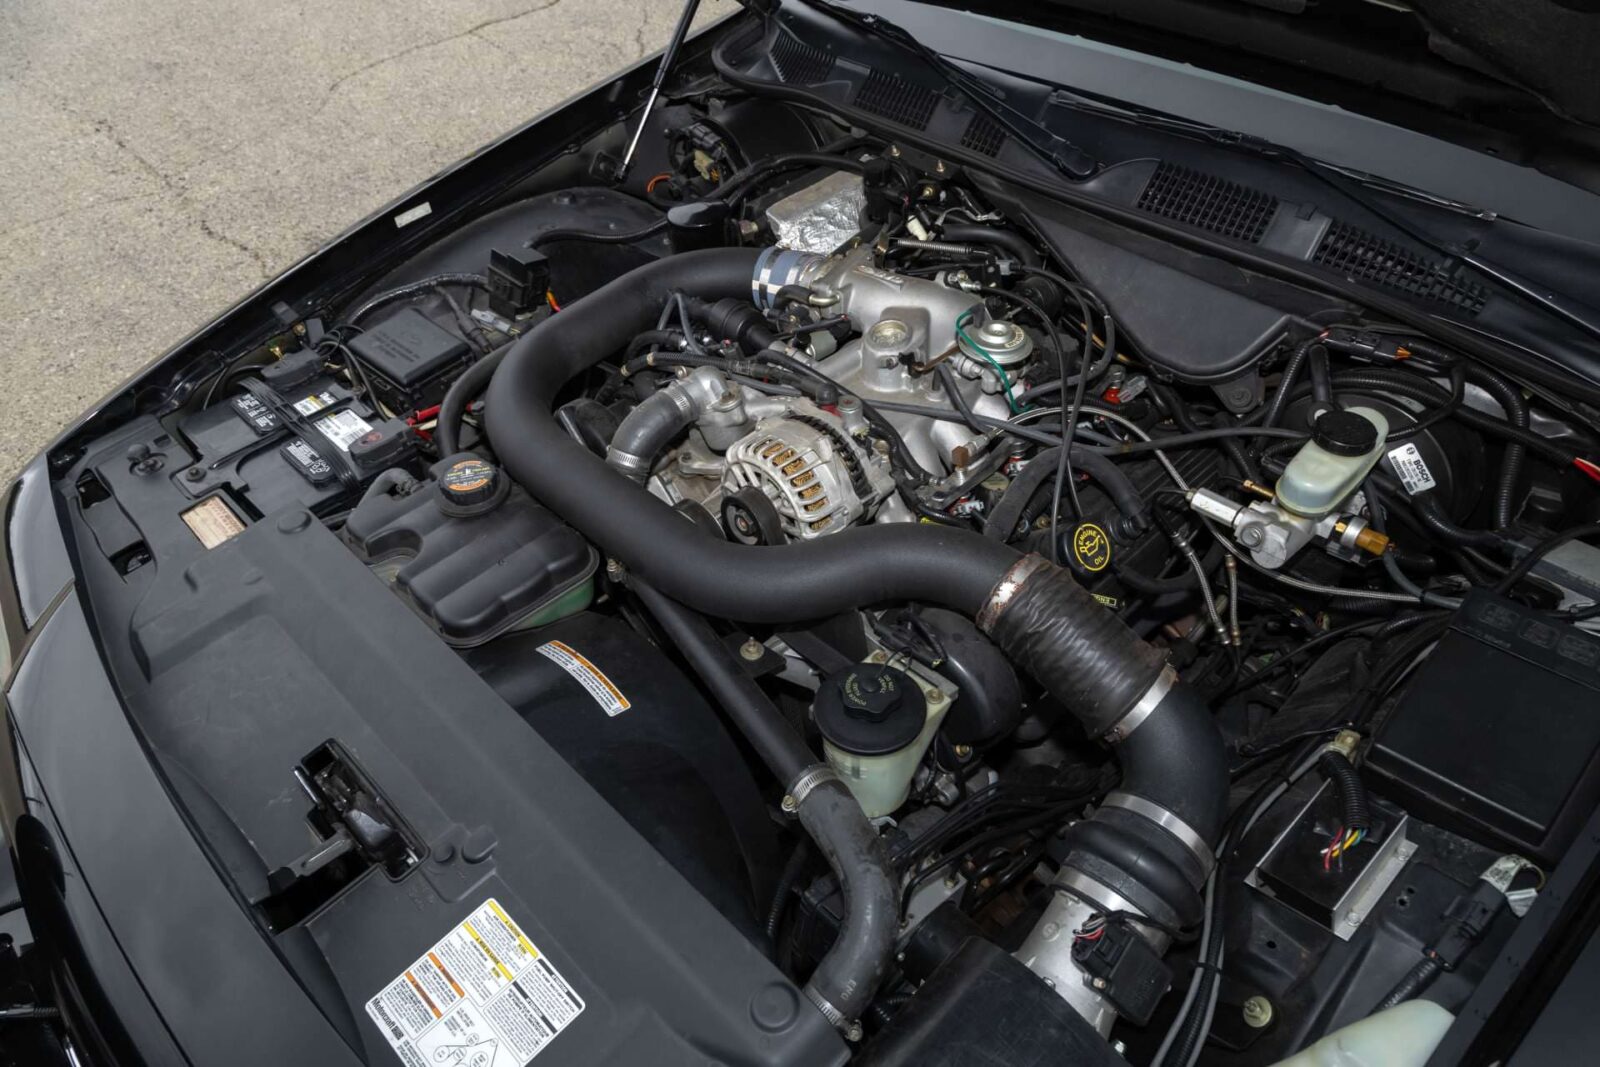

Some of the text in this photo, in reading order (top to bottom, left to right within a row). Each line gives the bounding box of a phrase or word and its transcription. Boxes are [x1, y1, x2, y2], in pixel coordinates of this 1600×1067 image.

[1413, 459, 1432, 483] BOSCH
[1079, 529, 1097, 545] ENGINE
[1095, 556, 1105, 566] OIL
[369, 997, 397, 1029] Motorcraft
